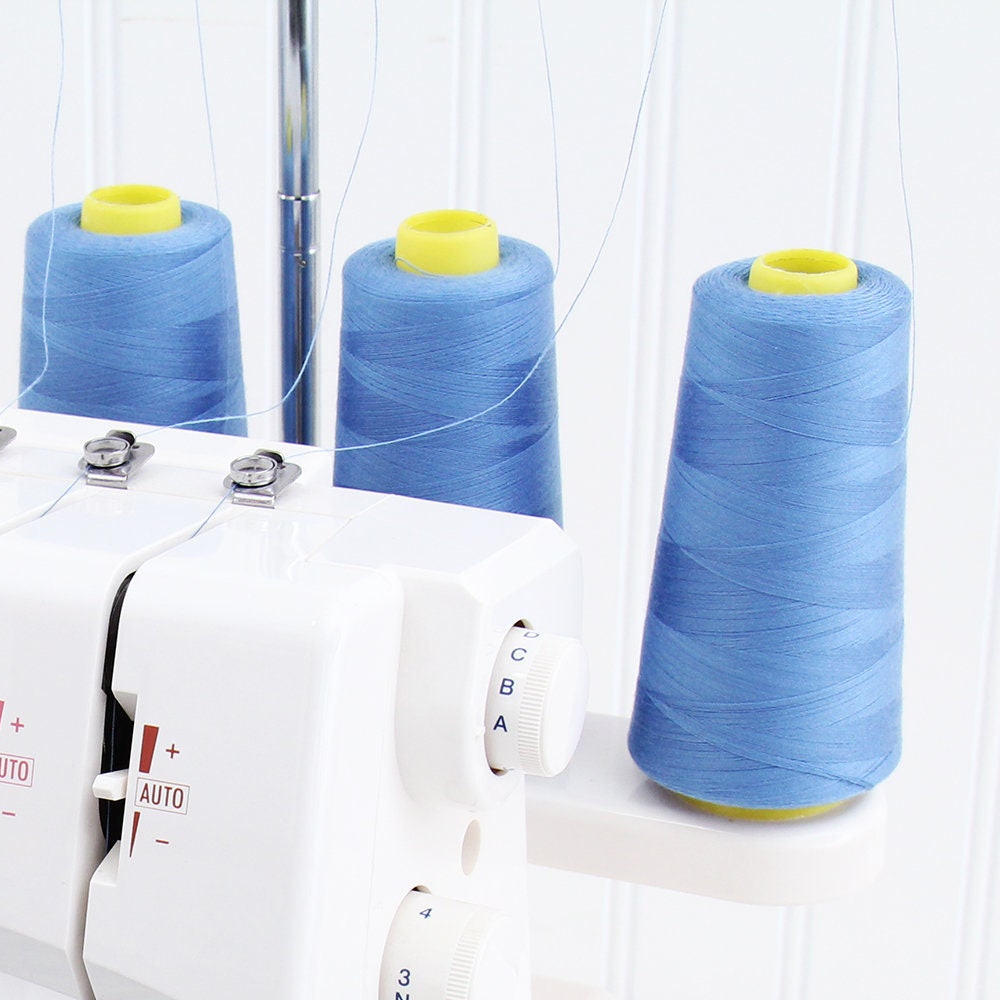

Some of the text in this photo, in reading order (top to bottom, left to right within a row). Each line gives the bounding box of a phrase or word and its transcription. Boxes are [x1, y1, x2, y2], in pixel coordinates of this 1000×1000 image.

[510, 647, 528, 662] C
[499, 677, 515, 697] B
[492, 714, 509, 734] A
[139, 784, 185, 809] AUTO
[418, 907, 434, 919] 4
[397, 968, 411, 987] 3
